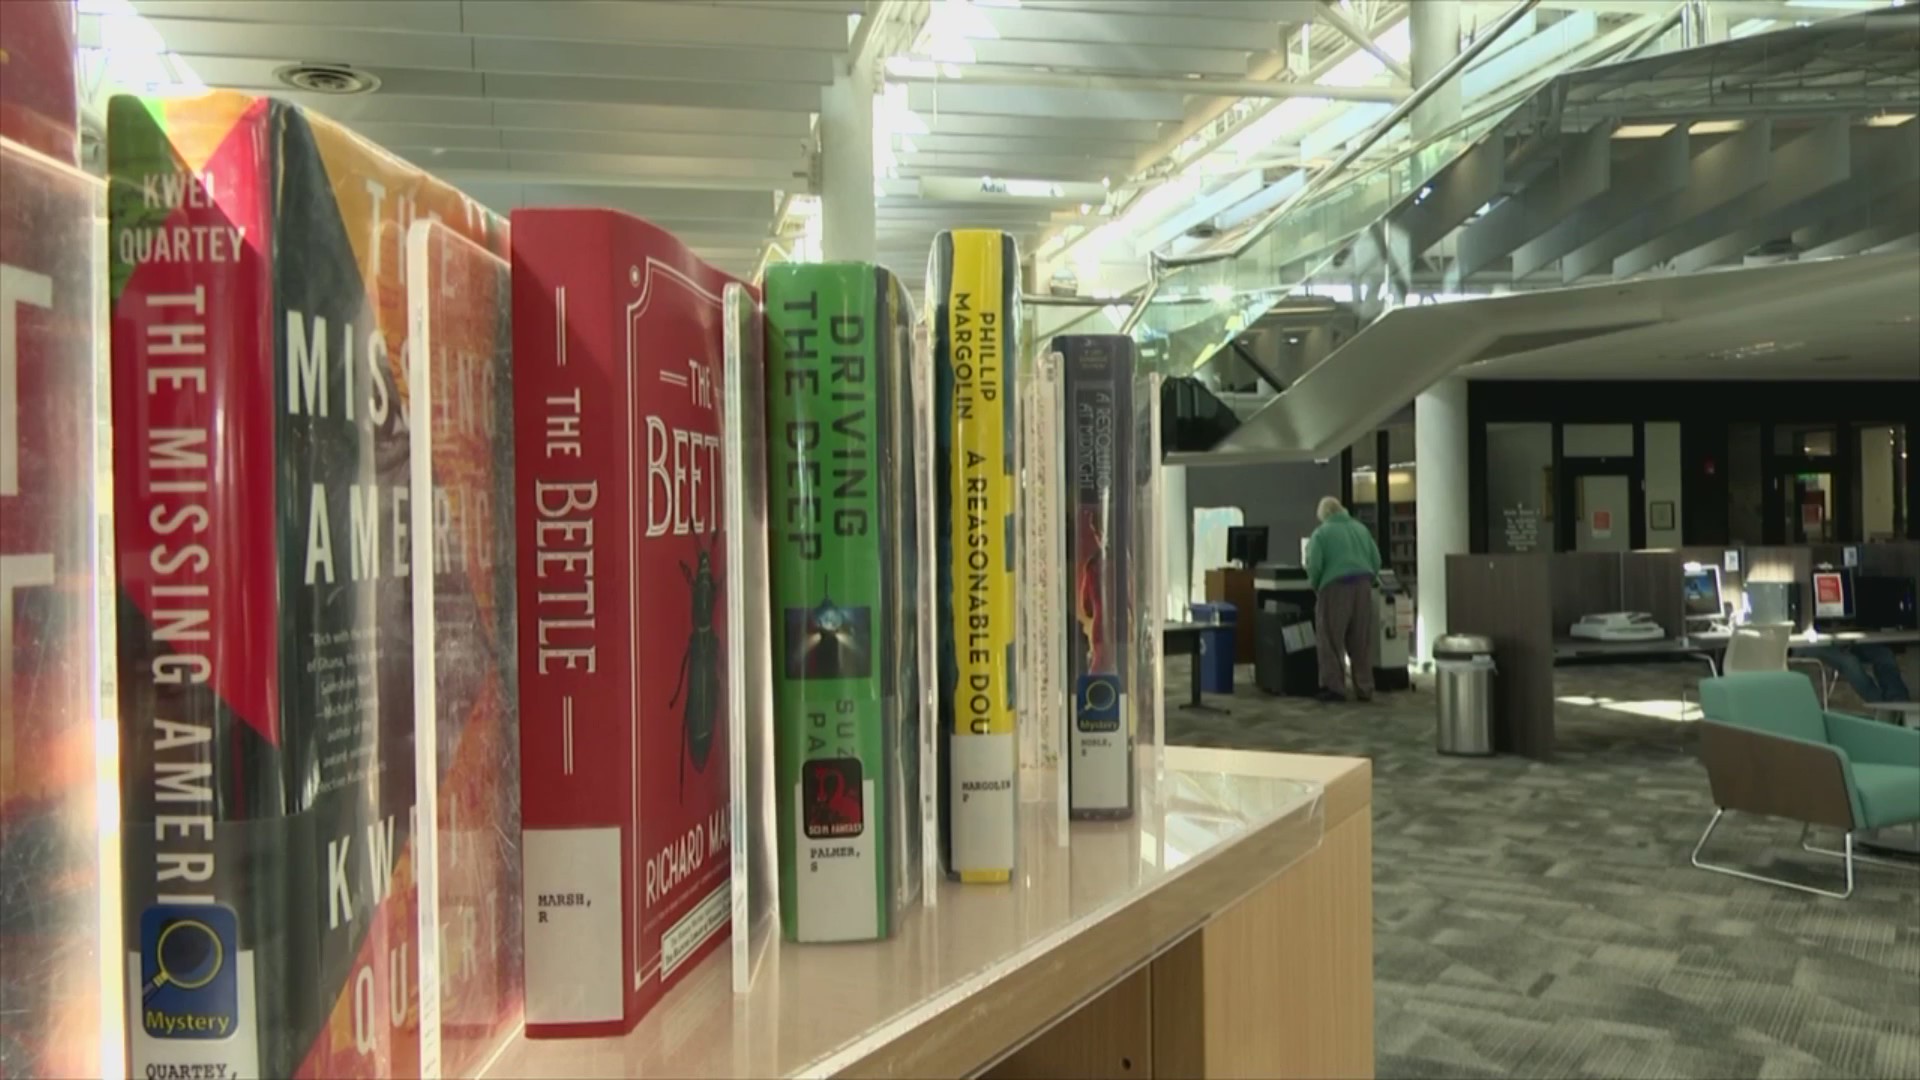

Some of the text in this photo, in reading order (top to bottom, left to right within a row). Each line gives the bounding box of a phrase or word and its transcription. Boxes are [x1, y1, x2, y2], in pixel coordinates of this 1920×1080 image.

[142, 173, 214, 208] KWEI
[119, 226, 247, 263] QUARTEY
[954, 293, 973, 420] MARGOLIN
[978, 311, 996, 402] PHILLIP
[689, 358, 713, 410] THE
[783, 290, 822, 561] THE DEEP
[830, 315, 868, 538] DRIVING
[646, 415, 728, 537] BEET
[535, 386, 598, 675] THE BEETLE
[146, 286, 215, 903] THE MISSING AMERI
[966, 451, 990, 735] A REASONABLE DOU
[807, 712, 826, 752] PA
[836, 699, 854, 759] SUZ
[962, 779, 1011, 791] MARGOLIN
[962, 793, 970, 803] P
[646, 824, 704, 909] RICHARD
[708, 803, 731, 857] MA
[810, 846, 860, 859] PALMER,
[538, 893, 592, 907] MARSH,
[538, 911, 548, 923] R
[146, 1010, 230, 1035] Mystery
[145, 1063, 237, 1080] QUARTEY,
